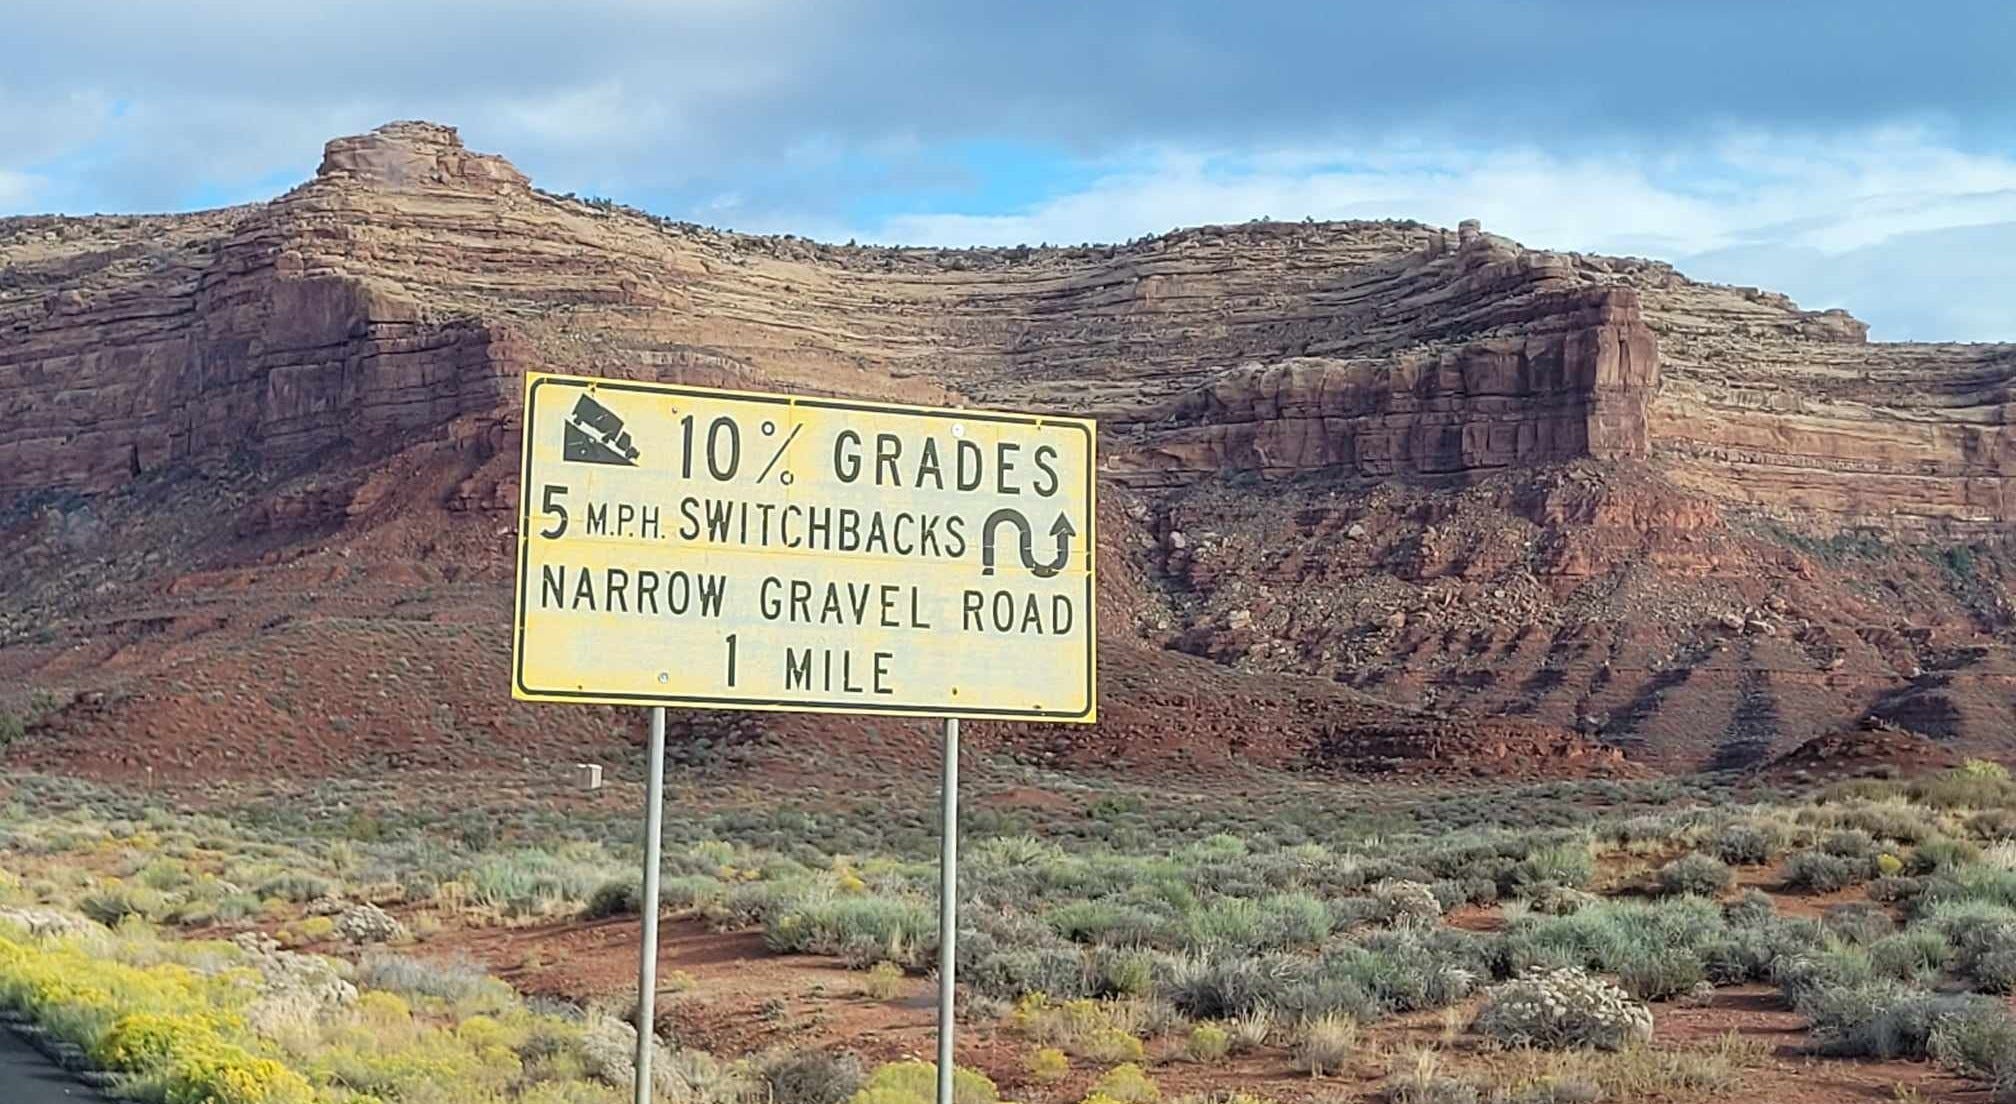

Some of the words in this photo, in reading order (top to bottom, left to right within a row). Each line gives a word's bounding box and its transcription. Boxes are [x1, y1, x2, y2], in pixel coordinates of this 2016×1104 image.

[833, 430, 1059, 497] GRADES
[540, 484, 568, 540] 5
[586, 503, 665, 540] M.P.H.
[679, 497, 966, 558] SWITCHBACKS
[541, 564, 727, 617] NARROW
[760, 576, 930, 629] GRAVEL
[963, 590, 1073, 635] ROAD
[725, 634, 737, 687] 1
[785, 647, 894, 694] MILE
